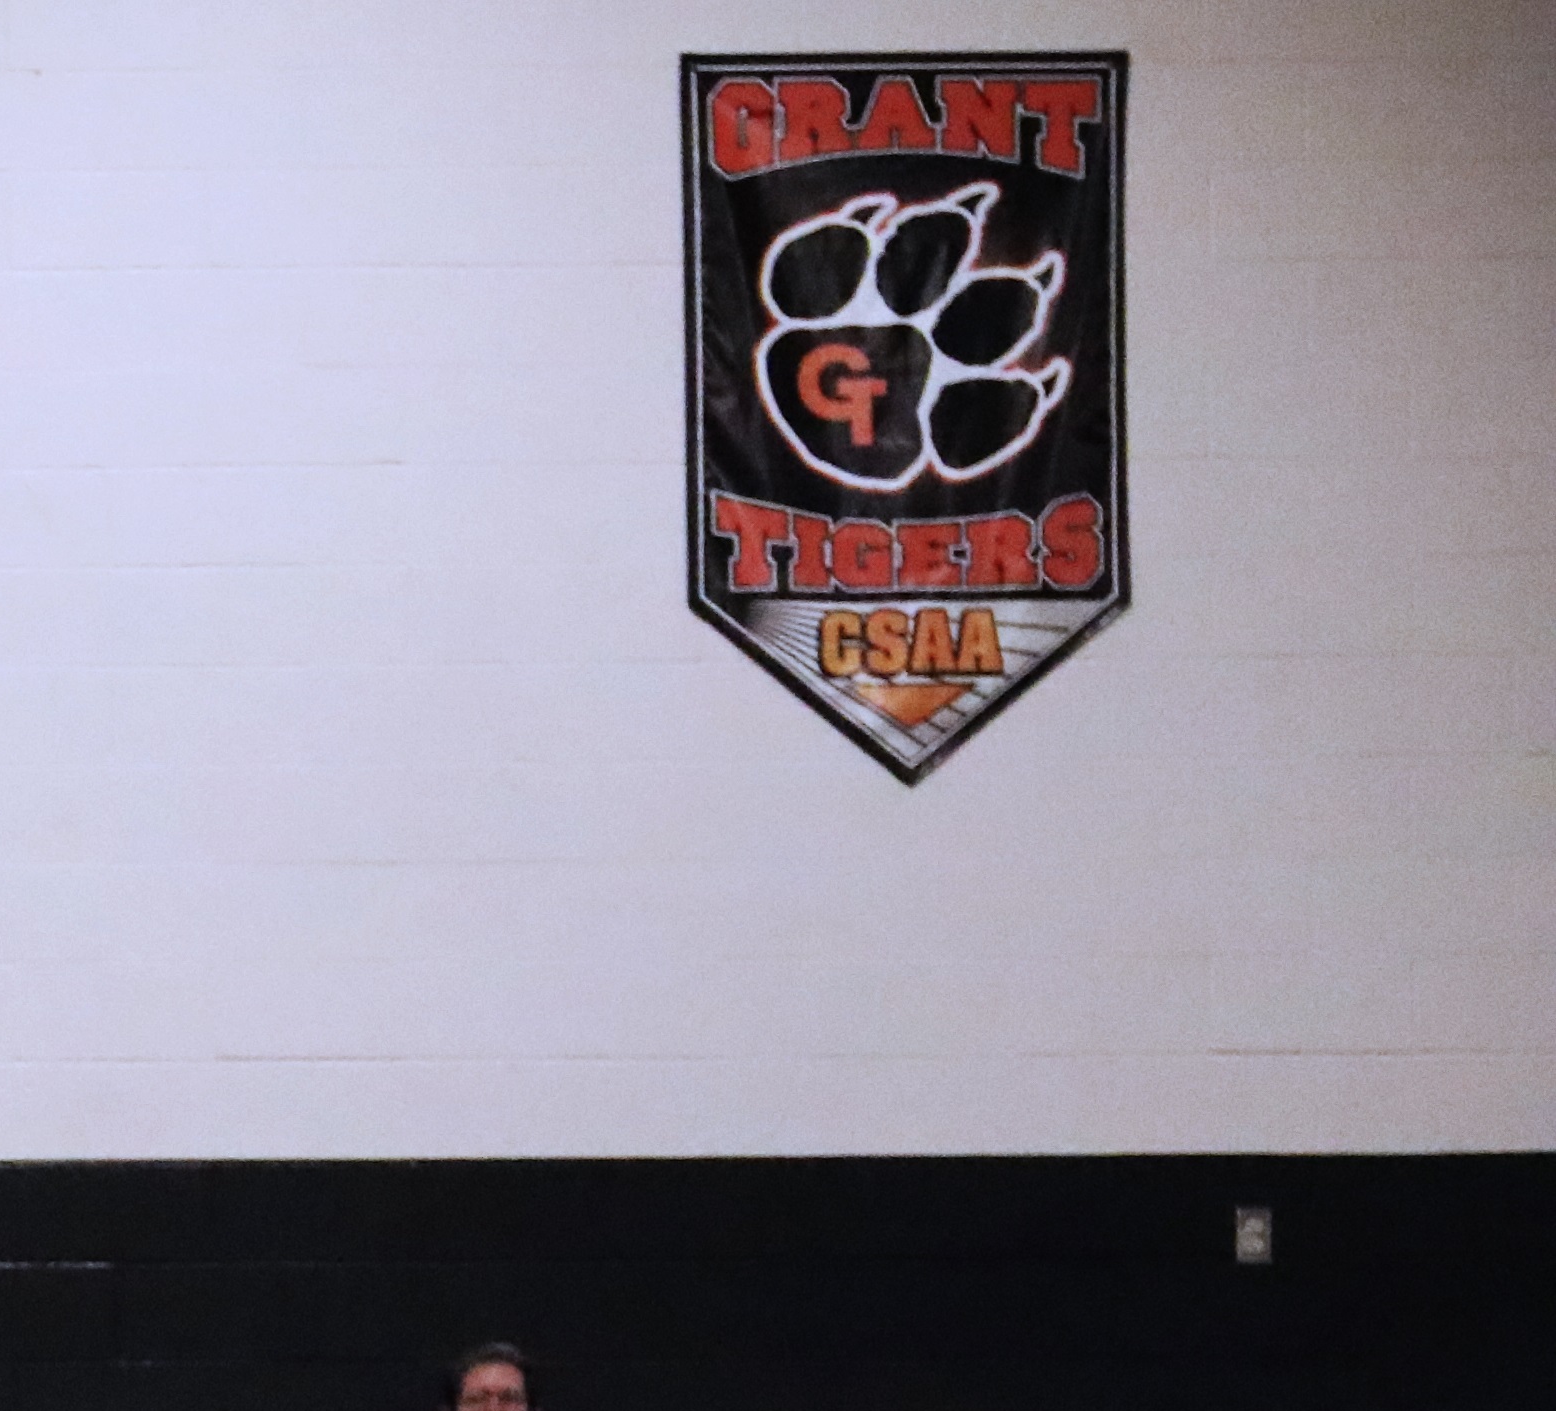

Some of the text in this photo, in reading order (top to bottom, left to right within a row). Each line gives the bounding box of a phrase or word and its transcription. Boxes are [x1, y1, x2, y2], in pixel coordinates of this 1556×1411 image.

[707, 75, 1102, 181] GRANT
[710, 489, 1104, 593] TIGERS
[819, 608, 1004, 677] CSAA
